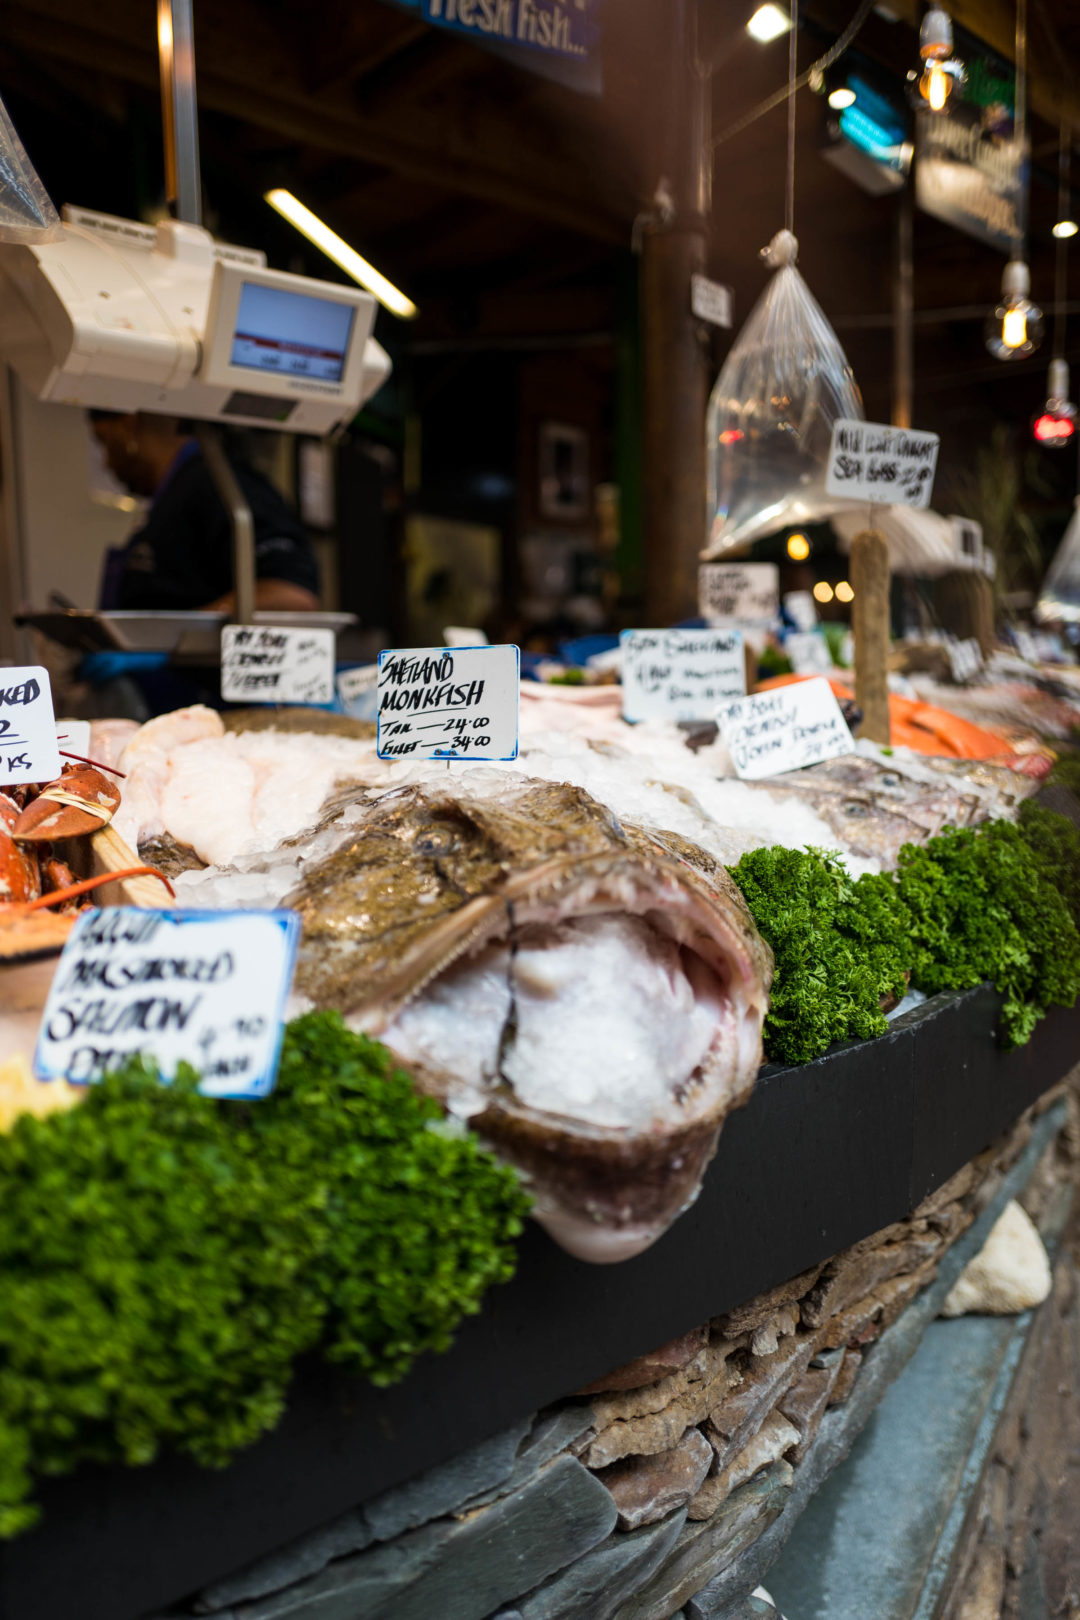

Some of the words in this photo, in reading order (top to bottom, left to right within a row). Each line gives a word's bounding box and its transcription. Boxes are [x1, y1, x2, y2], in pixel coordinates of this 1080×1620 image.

[378, 655, 454, 688] SHETLAND
[380, 680, 485, 711] MONKFISH
[380, 720, 412, 736] TAIL
[381, 740, 423, 755] FILLET
